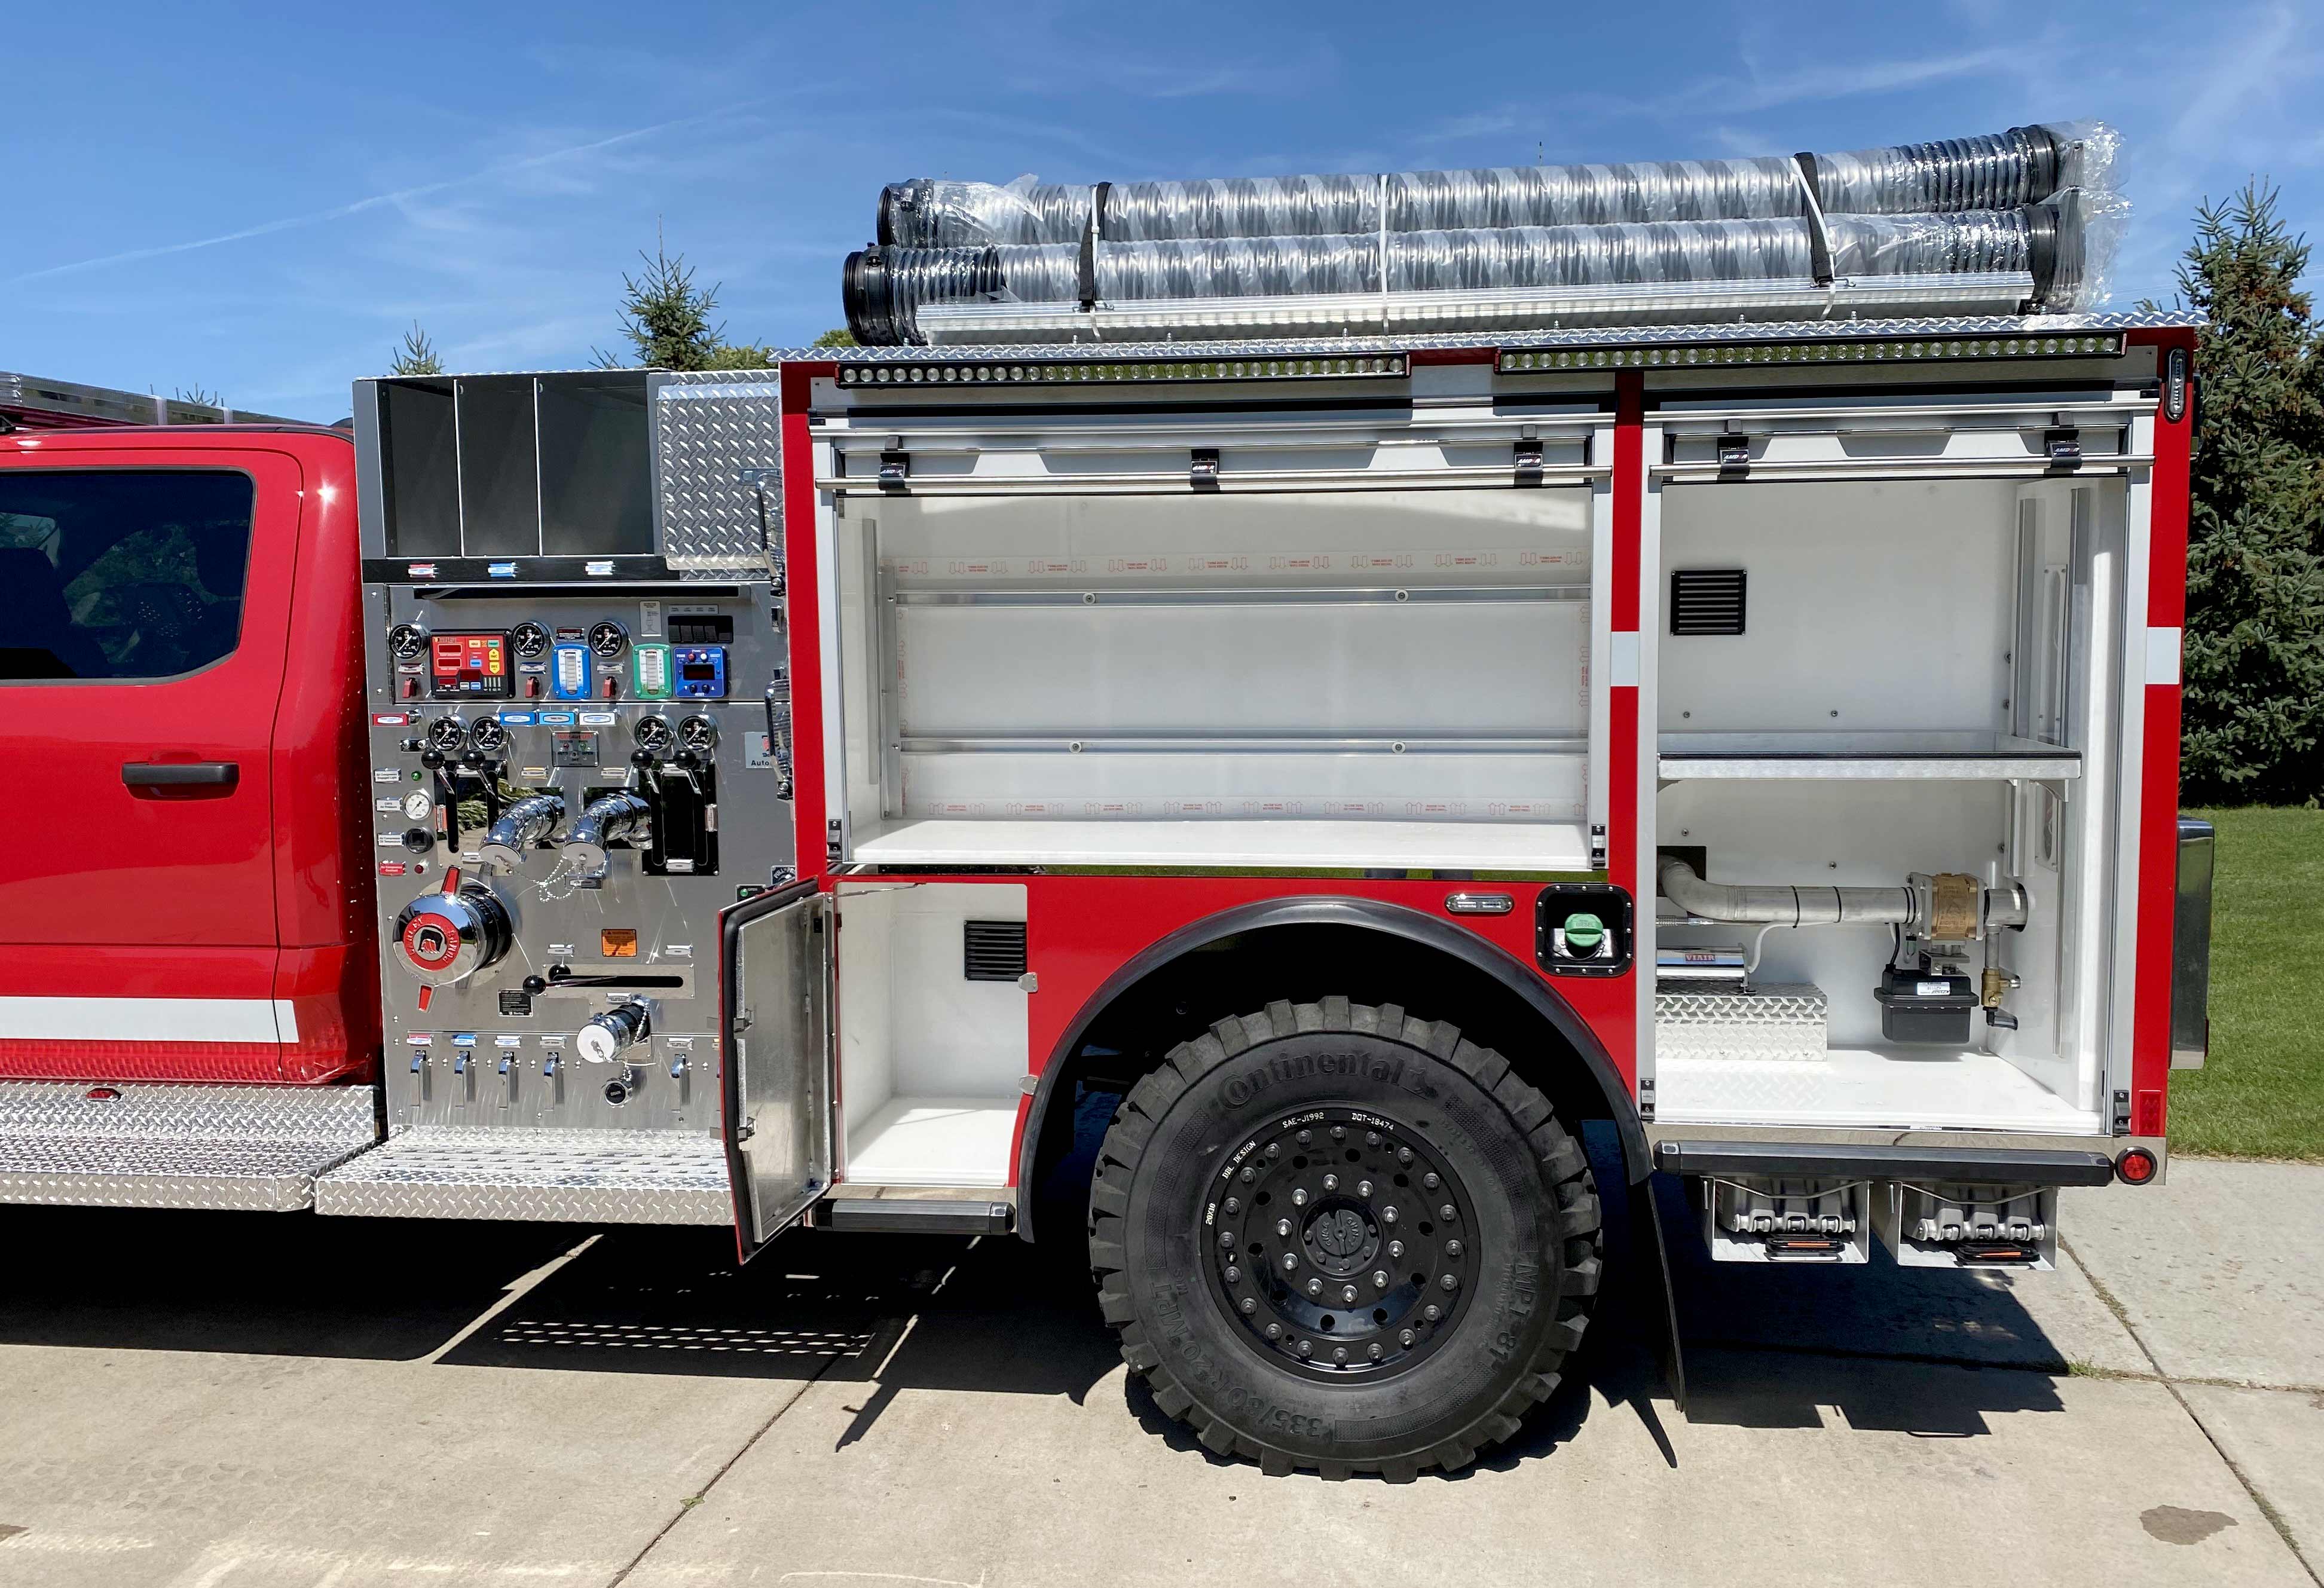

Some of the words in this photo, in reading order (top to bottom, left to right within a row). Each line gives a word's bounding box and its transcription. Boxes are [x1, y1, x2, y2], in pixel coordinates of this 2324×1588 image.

[1223, 1050, 1405, 1110] Continental
[1282, 1112, 1325, 1128] SAE-J1992
[1351, 1112, 1395, 1131] DOT-18474
[1222, 1165, 1235, 1179] DBL
[1233, 1140, 1256, 1164] DESIGN
[1205, 1202, 1216, 1225] 20X10
